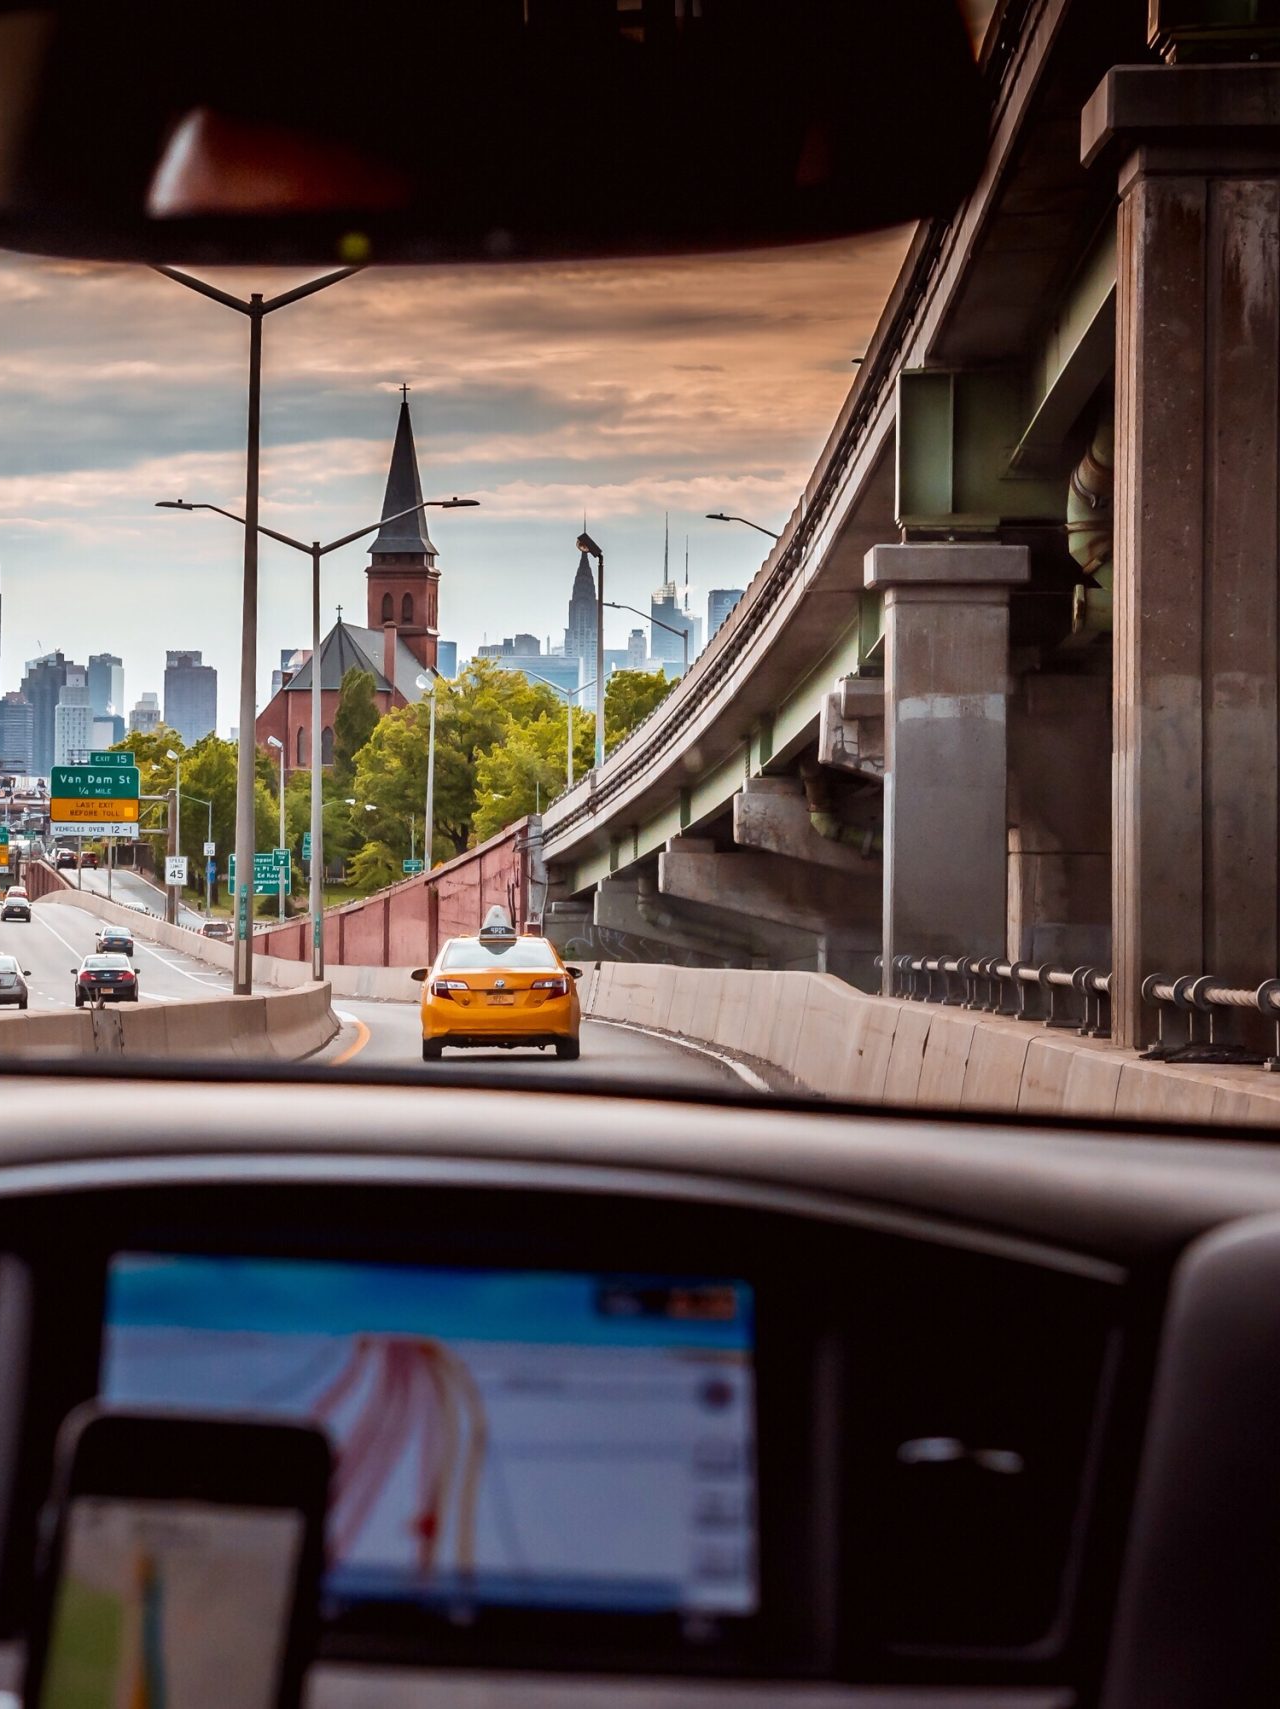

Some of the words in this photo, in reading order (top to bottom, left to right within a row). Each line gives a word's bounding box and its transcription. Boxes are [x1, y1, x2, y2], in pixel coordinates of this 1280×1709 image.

[116, 754, 127, 763] 15
[60, 774, 81, 784] Van
[87, 774, 113, 784] Dam
[118, 775, 131, 784] St
[169, 870, 184, 879] 45
